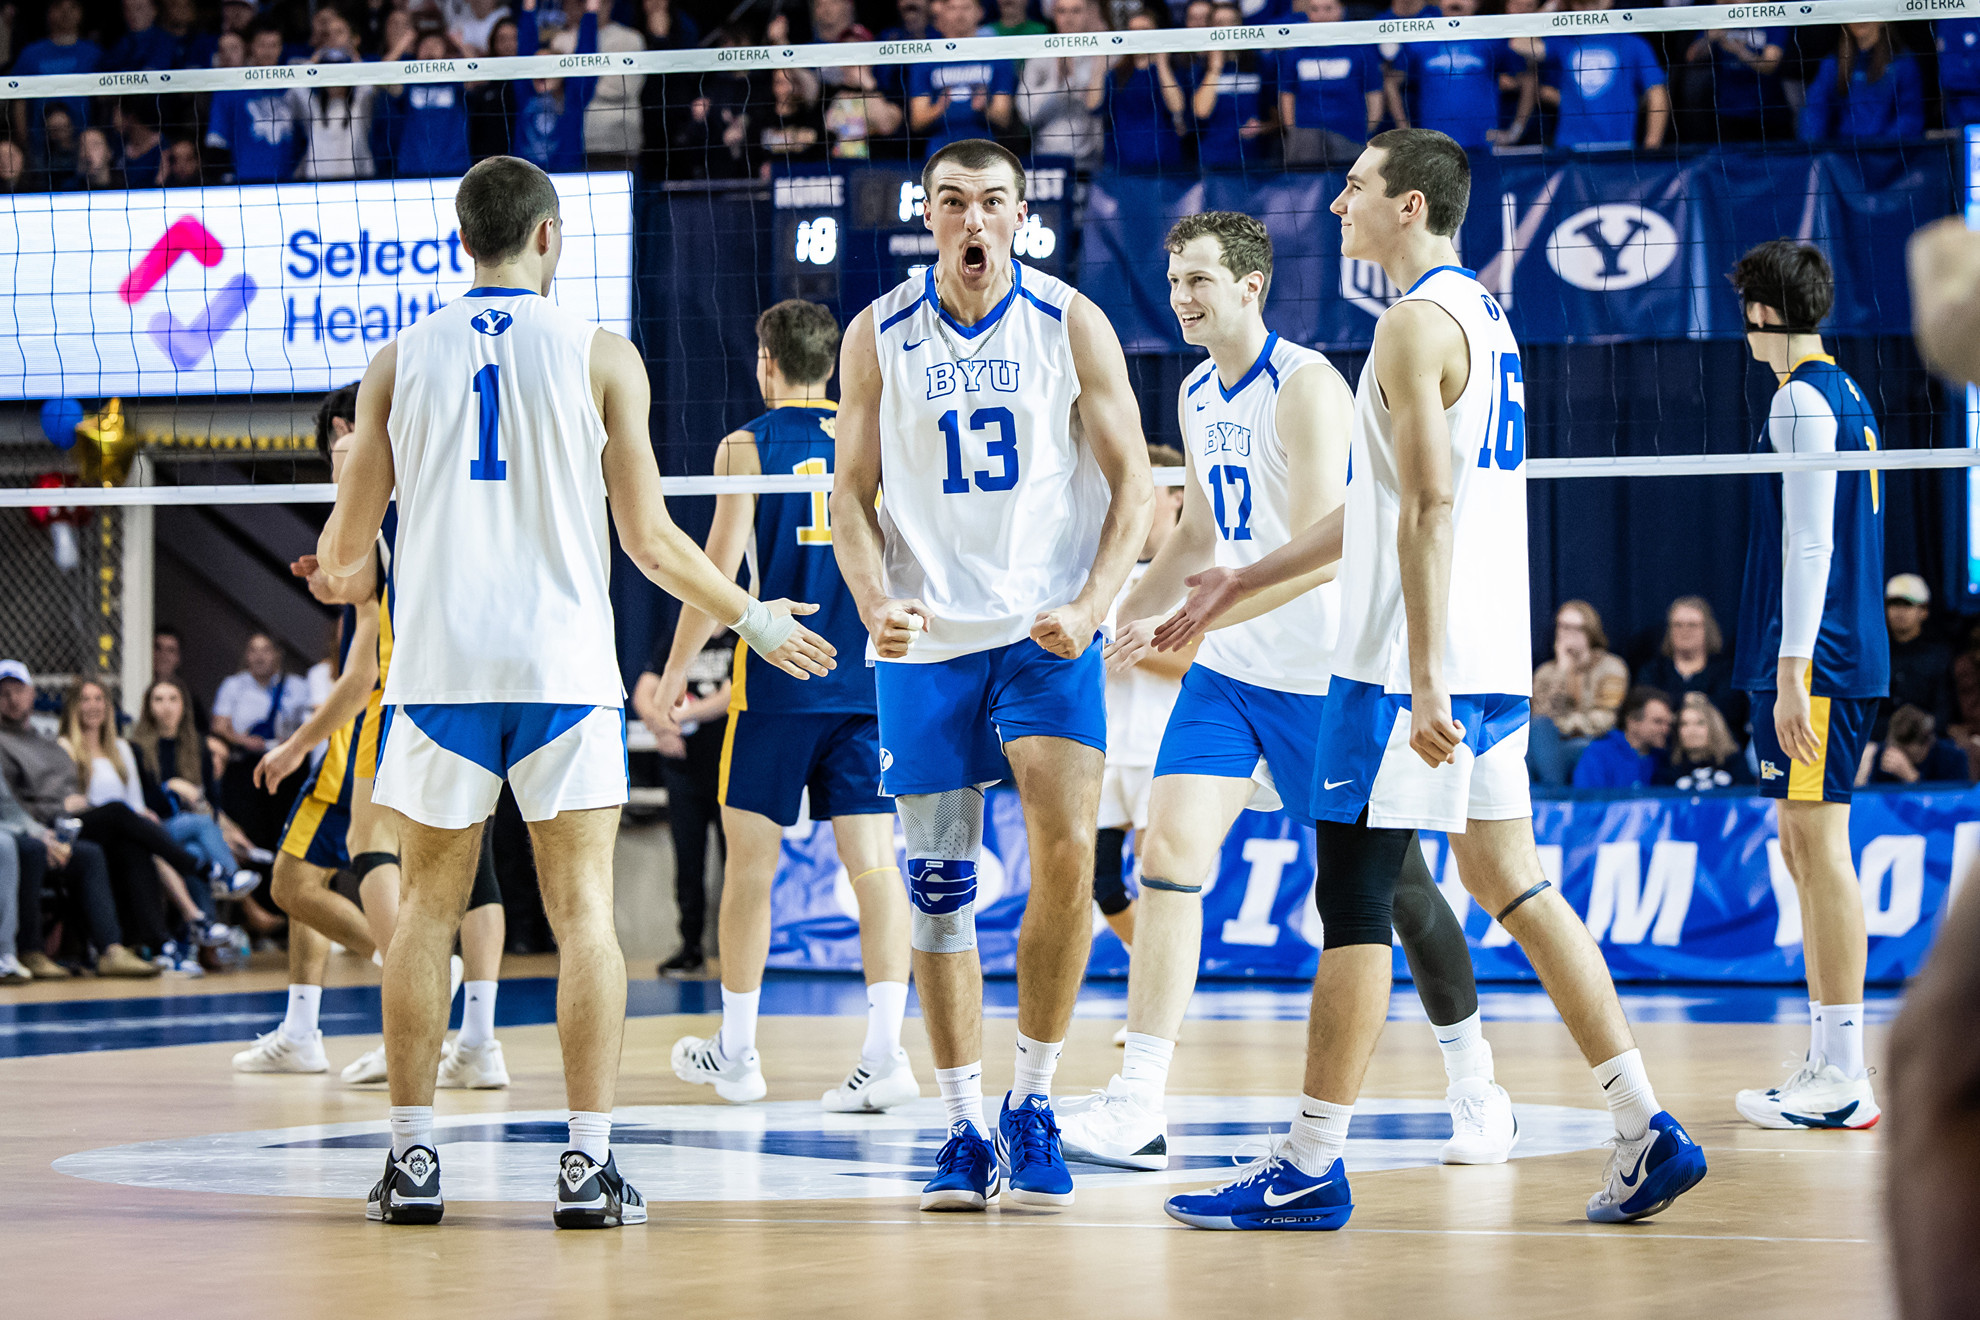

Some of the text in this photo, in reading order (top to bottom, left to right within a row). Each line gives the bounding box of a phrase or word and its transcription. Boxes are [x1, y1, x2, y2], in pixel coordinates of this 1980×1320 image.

[288, 229, 463, 278] Select
[927, 360, 1020, 400] BYU
[1477, 351, 1525, 471] 16
[470, 364, 507, 480] 1
[938, 406, 1020, 494] 13
[1204, 421, 1251, 456] BYU
[792, 457, 833, 545] 1
[1208, 464, 1253, 540] 17
